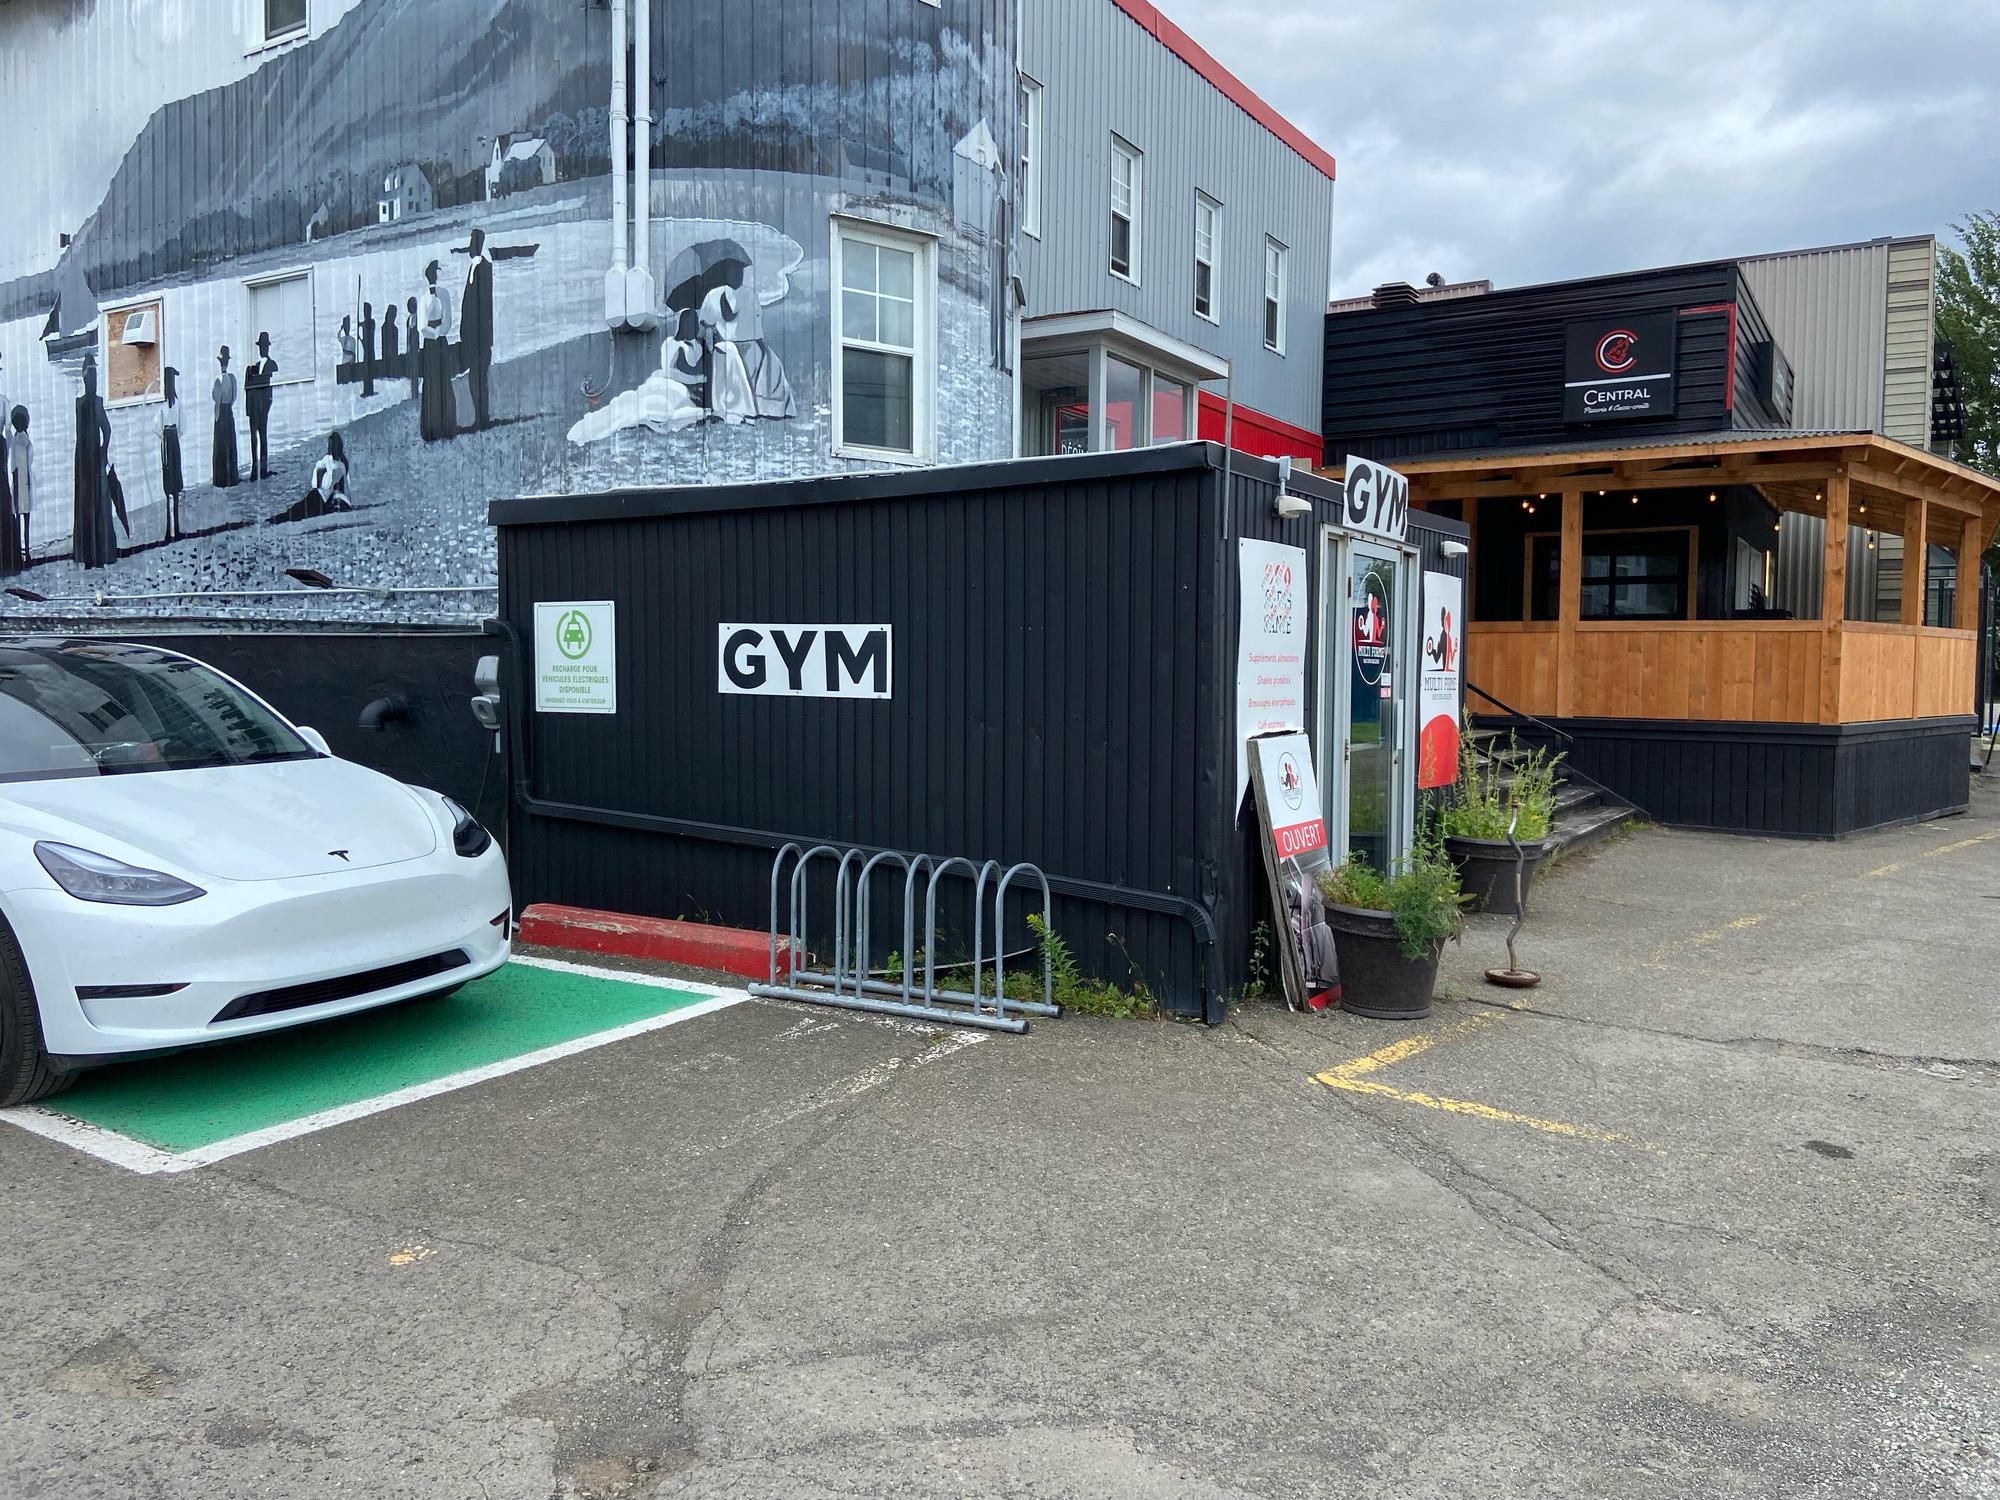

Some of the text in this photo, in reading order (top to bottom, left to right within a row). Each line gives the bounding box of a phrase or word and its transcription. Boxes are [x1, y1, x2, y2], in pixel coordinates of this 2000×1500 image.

[1584, 388, 1651, 405] CENTRAL
[1347, 463, 1407, 537] GYM
[552, 665, 598, 673] RECHARGE POUR
[723, 629, 888, 693] GYM
[559, 686, 591, 694] DISPONIBLE
[1282, 823, 1321, 853] OUVERT
